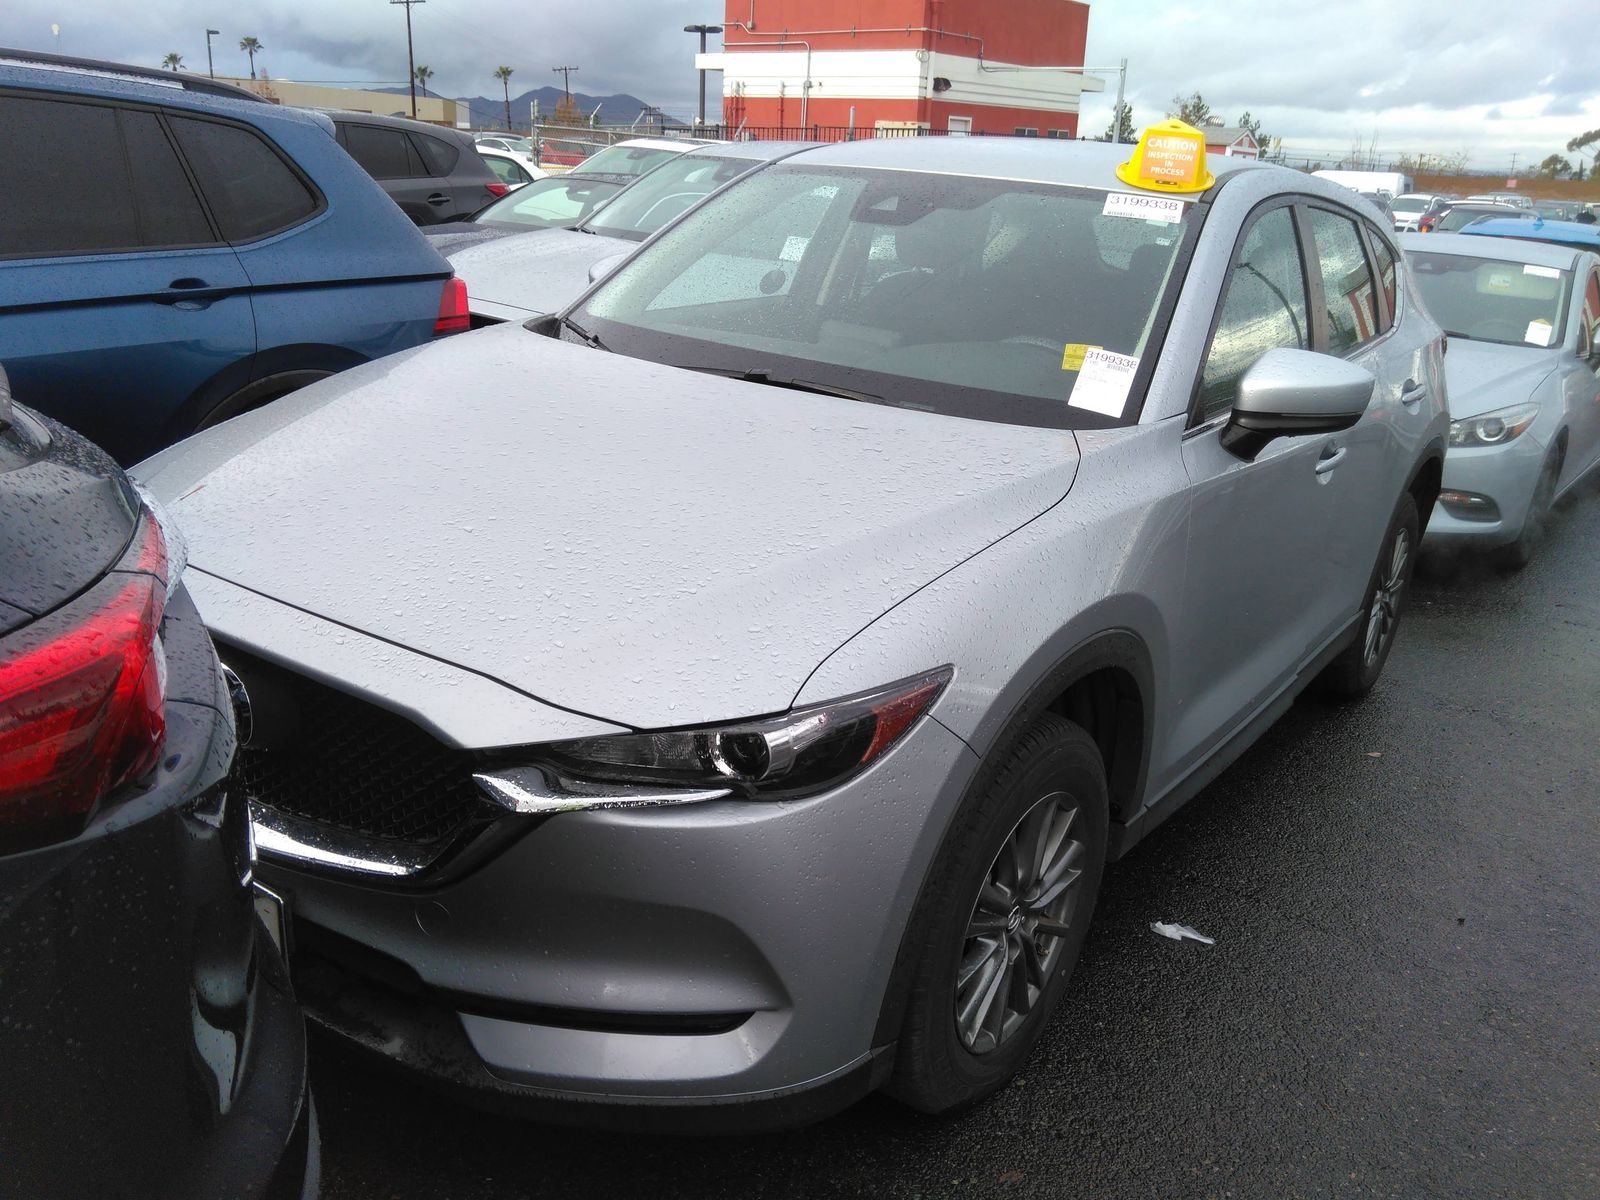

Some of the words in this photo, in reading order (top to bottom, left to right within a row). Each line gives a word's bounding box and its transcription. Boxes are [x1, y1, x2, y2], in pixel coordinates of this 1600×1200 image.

[1147, 138, 1198, 151] CAUTION
[1147, 151, 1194, 161] INSPECTION
[1150, 167, 1185, 176] PROCESS
[1110, 195, 1178, 211] 3199338
